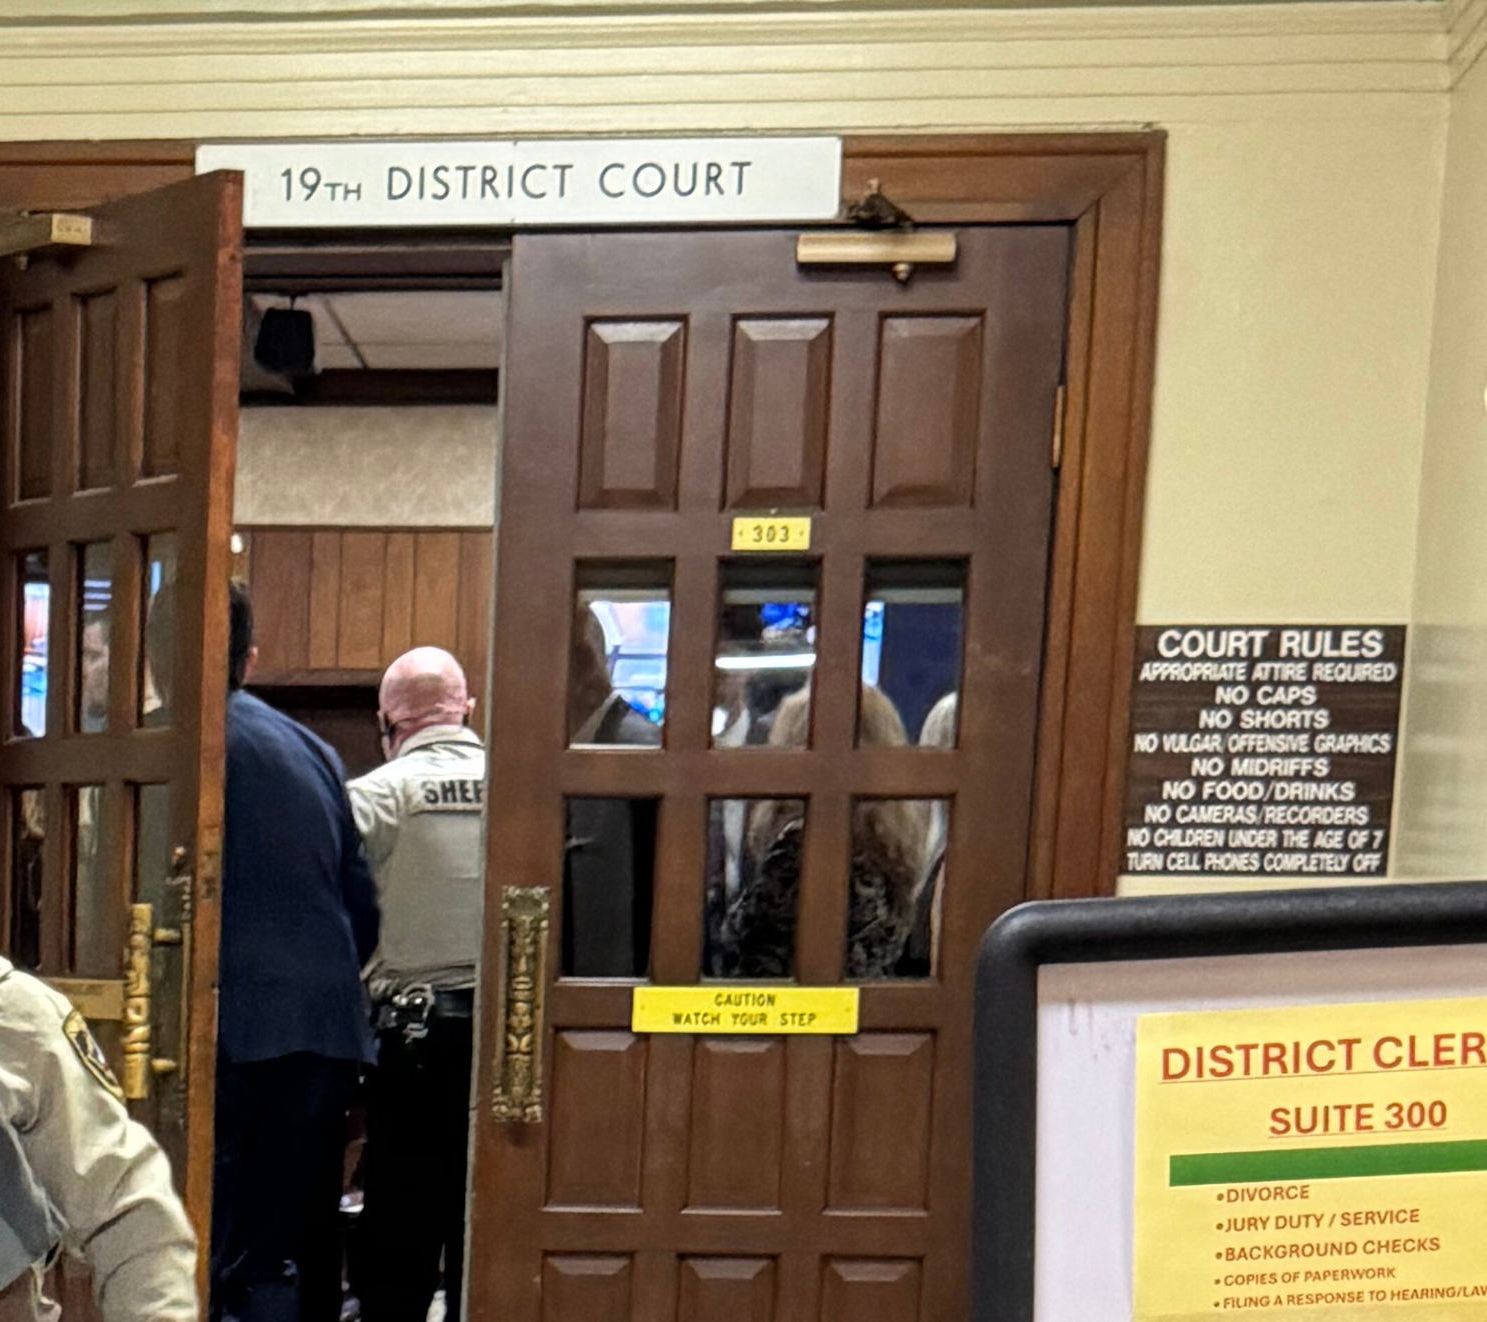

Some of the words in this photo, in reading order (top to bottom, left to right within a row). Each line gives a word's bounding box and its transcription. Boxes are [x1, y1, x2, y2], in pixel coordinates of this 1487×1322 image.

[281, 166, 362, 202] 19TH
[387, 163, 573, 200] DISTRICT
[599, 161, 752, 198] COURT
[753, 525, 789, 543] 303
[1158, 629, 1270, 658] COURT
[1279, 629, 1384, 658] RULES
[1140, 662, 1246, 682] APPROPRIATE
[1252, 662, 1307, 682] ATTIRE
[1312, 662, 1396, 682] REQUIRED
[1215, 685, 1249, 705] NO
[1257, 685, 1317, 705] CAPS
[1199, 709, 1233, 729] NO
[1240, 709, 1330, 729] SHORTS
[1134, 734, 1158, 753] NO
[1315, 734, 1392, 753] GRAPHICS
[1191, 757, 1224, 777] NO
[1231, 757, 1330, 777] MIDRIFFS
[1163, 781, 1195, 800] NO
[1202, 781, 1355, 801] FOOD/DRINKS
[1144, 805, 1171, 824] NO
[1175, 805, 1369, 824] CAMERAS/RECORDERS
[1127, 828, 1150, 847] NO
[1154, 829, 1225, 847] CHILDREN
[1228, 829, 1277, 848] UNDER
[1282, 829, 1310, 848] THE
[1313, 829, 1343, 848] AGE
[1347, 830, 1368, 848] OF
[1373, 830, 1384, 848] 7
[1127, 852, 1163, 871] TURN
[1166, 852, 1201, 871] CELL
[1204, 853, 1260, 871] PHONES
[1264, 853, 1350, 872] COMPLETELY
[1353, 853, 1382, 872] OFF
[714, 994, 776, 1007] CAUTION
[672, 1013, 720, 1026] WATCH
[731, 1013, 767, 1026] YOUR
[780, 1013, 817, 1026] STEP
[1162, 1037, 1361, 1080] DISTRICT
[1374, 1032, 1487, 1068] CLER
[1269, 1102, 1374, 1135] SUITE
[1384, 1100, 1447, 1129] 300
[1226, 1185, 1310, 1203] DIVORCE
[1226, 1216, 1270, 1233] JURY
[1275, 1214, 1325, 1230] DUTY
[1340, 1209, 1420, 1226] SERVICE
[1225, 1241, 1358, 1262] BACKGROUND
[1363, 1237, 1441, 1255] CHECKS
[1224, 1272, 1277, 1286] COPIES
[1282, 1271, 1300, 1283] OF
[1304, 1267, 1396, 1282] PAPERWORK
[1223, 1296, 1270, 1309] FILING
[1273, 1295, 1283, 1307] A
[1287, 1291, 1364, 1306] RESPONSE
[1369, 1290, 1386, 1302] TO
